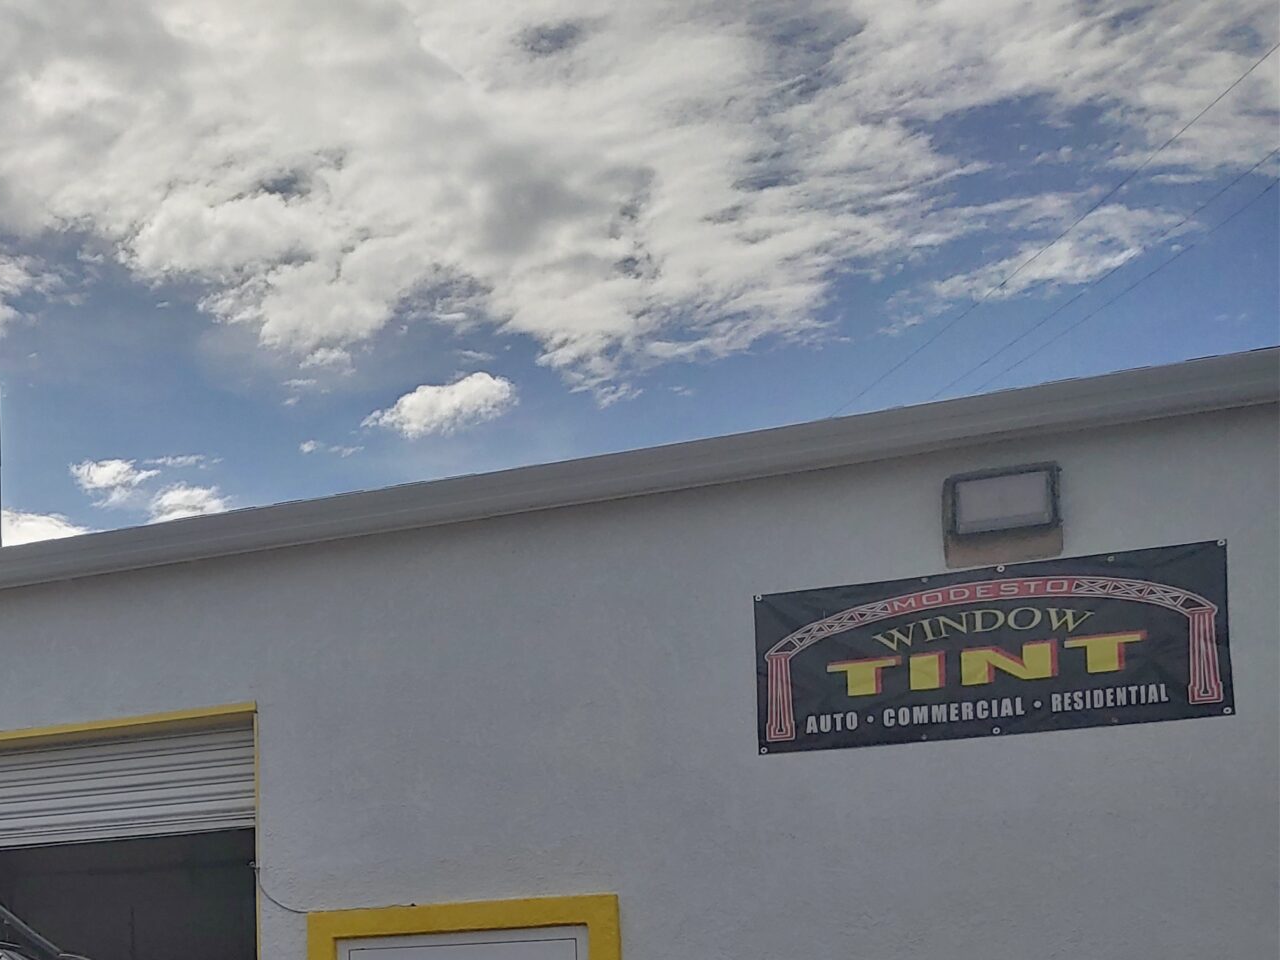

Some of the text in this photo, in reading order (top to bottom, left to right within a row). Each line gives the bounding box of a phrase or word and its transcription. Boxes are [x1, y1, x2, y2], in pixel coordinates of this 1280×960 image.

[892, 579, 1069, 611] MODESTO
[871, 606, 1095, 652] WINDOW
[826, 630, 1148, 697] TINT
[805, 683, 1170, 735] AUTO COMMERCIAL RESIDENTIAL
